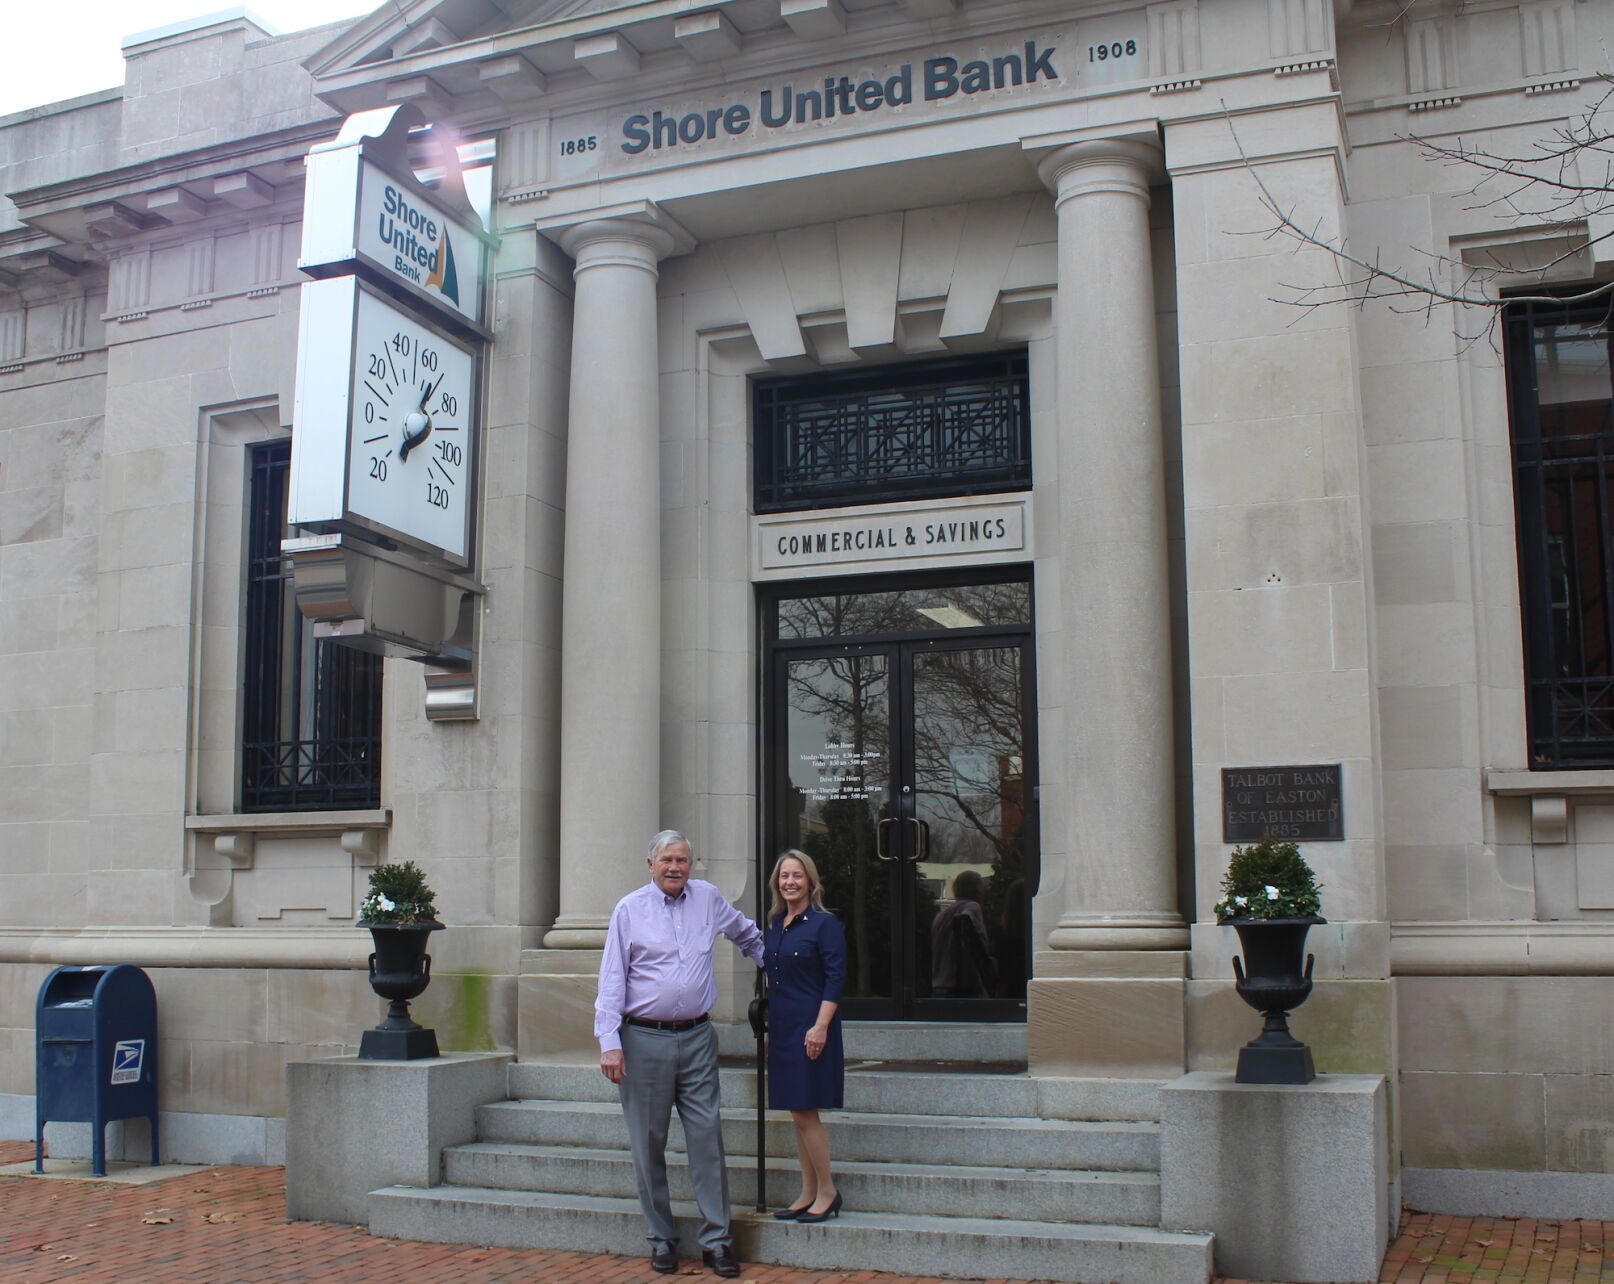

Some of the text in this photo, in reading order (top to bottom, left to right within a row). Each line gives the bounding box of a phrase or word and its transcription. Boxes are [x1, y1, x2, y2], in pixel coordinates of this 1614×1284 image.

[1088, 40, 1138, 63] 1908
[621, 41, 1058, 155] Shore United Bank
[560, 136, 598, 157] 1885
[384, 185, 437, 242] Shore
[379, 212, 439, 275] United
[394, 255, 420, 283] Bank
[392, 332, 410, 357] 40
[369, 354, 386, 380] 20
[421, 347, 438, 372] 60
[365, 401, 374, 424] 0
[441, 391, 457, 417] 80
[441, 440, 462, 467] 100
[370, 456, 387, 482] 20
[427, 483, 449, 509] 120
[778, 518, 1006, 556] COMMERCIAL & SAVINGS
[1227, 771, 1336, 787] TALBOT BANK
[1237, 789, 1327, 804] OF EASTON
[1228, 808, 1337, 824] ESTABLISHED
[1264, 823, 1301, 837] 1885
